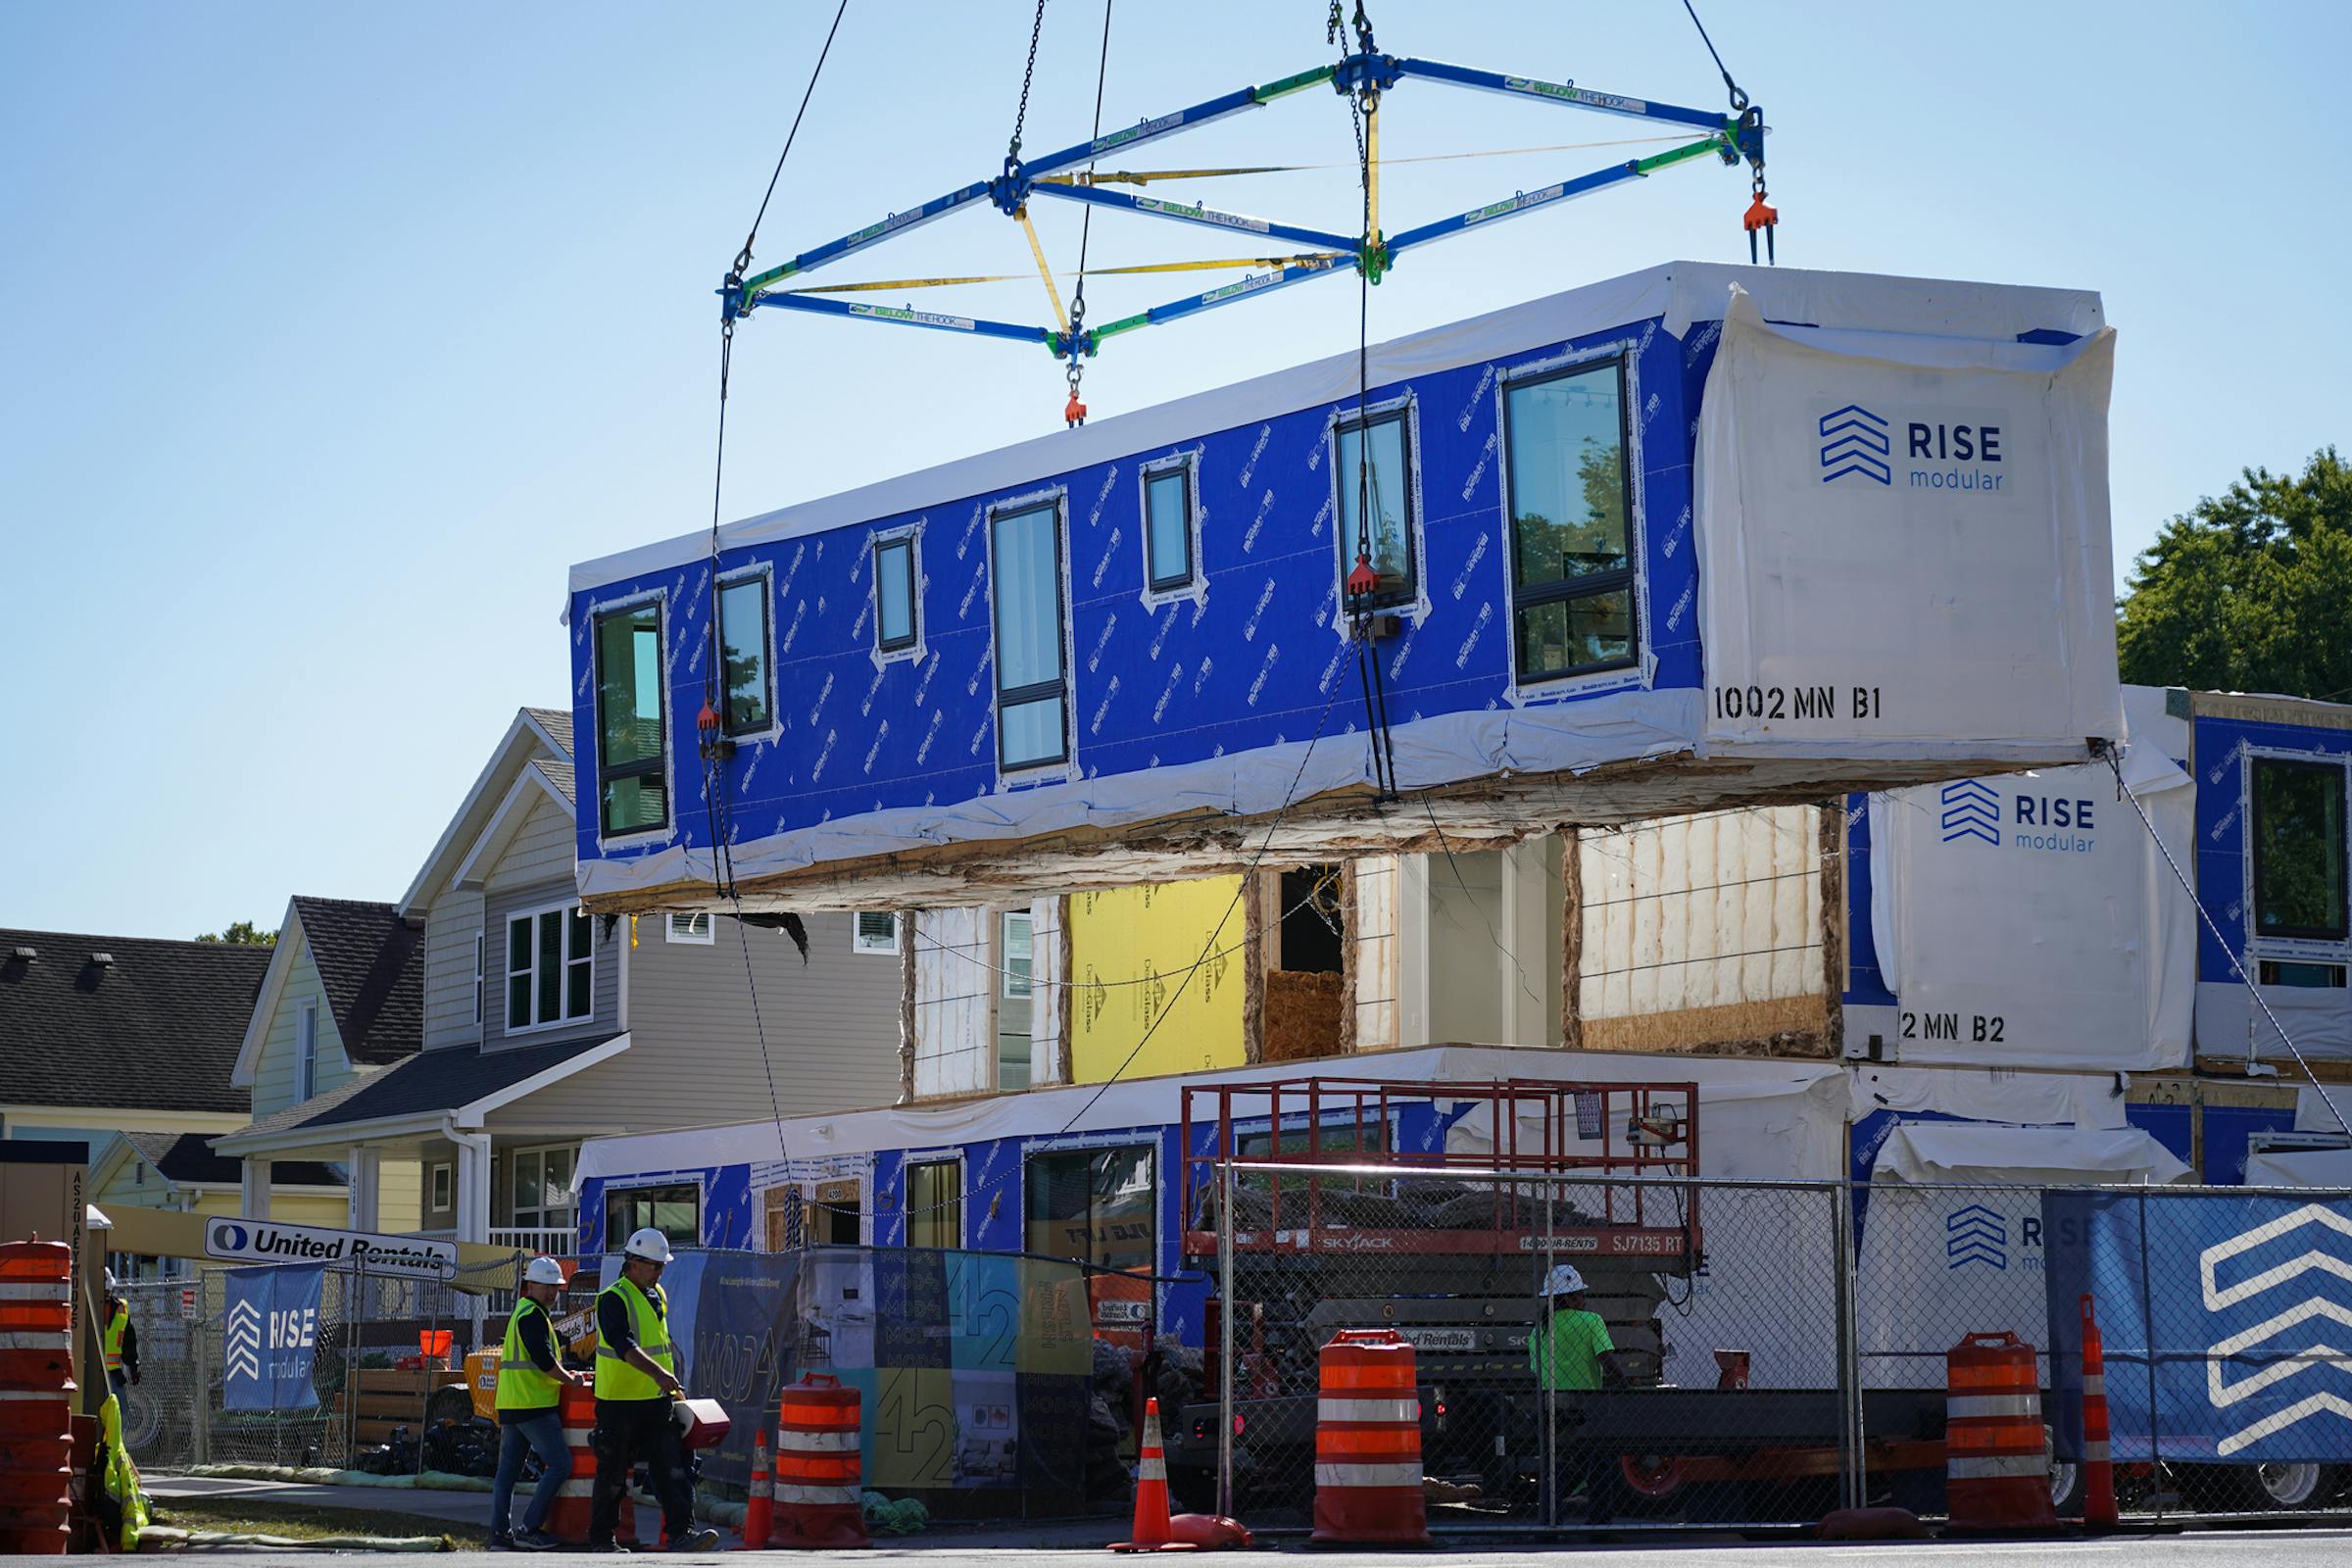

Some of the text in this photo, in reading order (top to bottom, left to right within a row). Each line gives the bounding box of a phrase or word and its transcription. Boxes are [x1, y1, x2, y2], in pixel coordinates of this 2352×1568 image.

[1163, 202, 1204, 218] BELOW
[1909, 423, 2001, 462] RISE
[1462, 462, 1486, 503] Blueskin
[1910, 467, 2003, 491] modular
[1468, 533, 1489, 573] Blueskin
[1668, 590, 1690, 631] Blueskin
[1457, 630, 1480, 670] Blueskin
[1715, 686, 1880, 719] 1002 MN B1
[2016, 795, 2094, 829] RISE
[2016, 833, 2094, 853] modular
[1902, 1011, 2004, 1043] 2 MN B2
[1873, 1112, 1901, 1145] Blueskin
[255, 1229, 444, 1270] United Rentals
[1323, 1233, 1393, 1250] SKYJACK
[1522, 1238, 1595, 1249] 1-800R-RENTS
[1613, 1235, 1683, 1252] SJ7135 RT
[270, 1308, 315, 1349] RISE
[1423, 1334, 1470, 1346] Rentals
